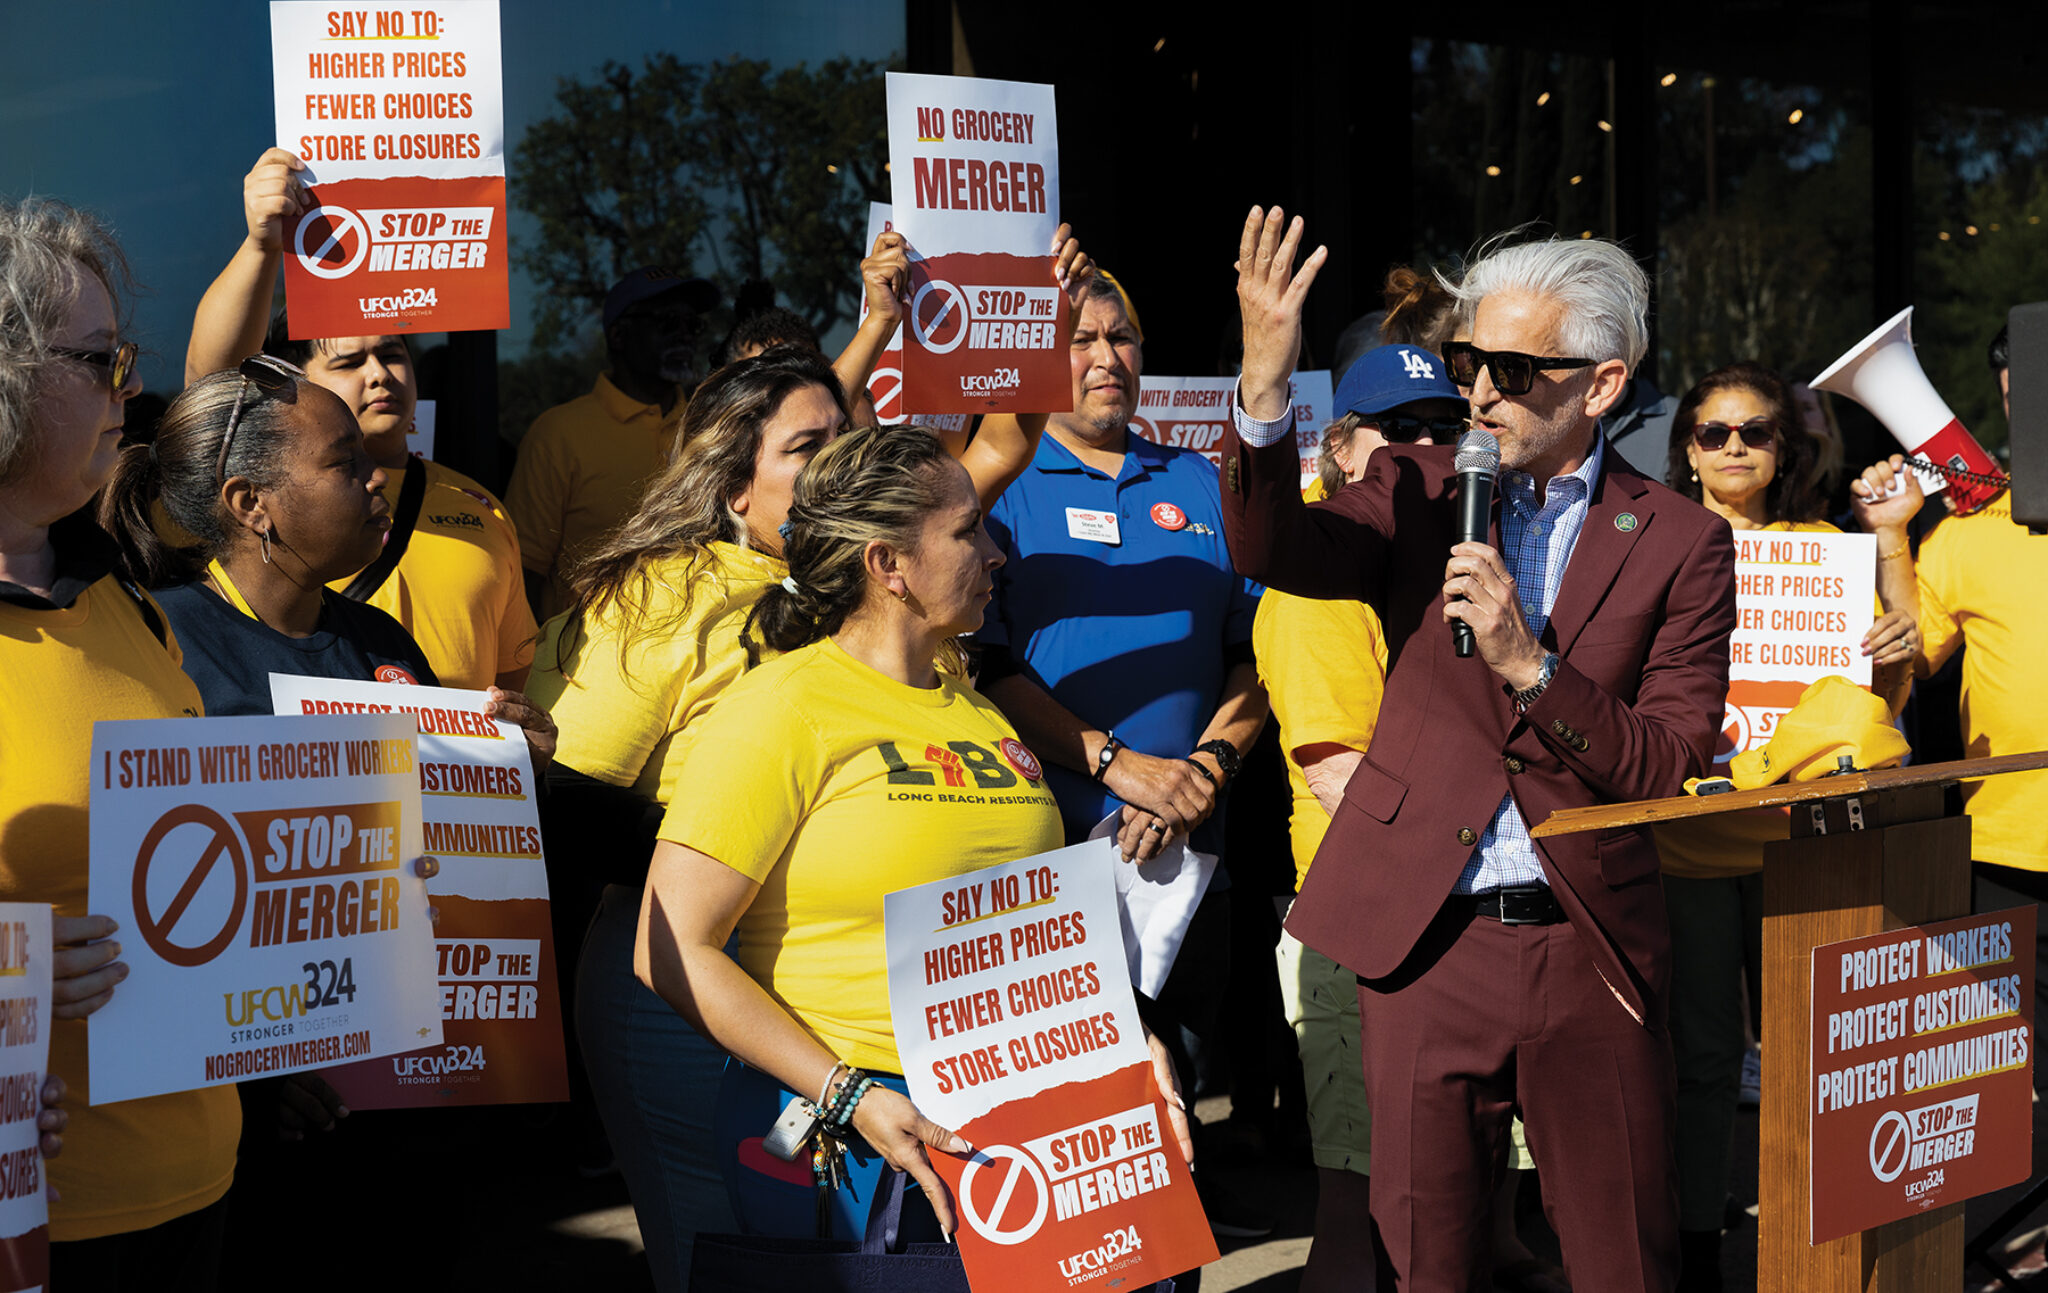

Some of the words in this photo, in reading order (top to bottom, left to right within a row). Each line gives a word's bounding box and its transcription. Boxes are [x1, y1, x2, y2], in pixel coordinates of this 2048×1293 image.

[328, 11, 367, 37] SAY
[376, 11, 404, 37] NO
[411, 11, 444, 37] TO:
[308, 52, 384, 78] HIGHER
[393, 52, 466, 78] PRICES
[305, 94, 375, 120] FEWER
[384, 93, 472, 119] CHOICES
[917, 106, 945, 138] NO
[952, 108, 1034, 144] GROCERY
[300, 135, 366, 161] STORE
[373, 133, 480, 160] CLOSURES
[913, 157, 1046, 213] MERGER
[379, 213, 446, 238] STOP
[452, 219, 483, 236] THE
[368, 242, 487, 272] MERGER
[363, 311, 398, 319] STRONGER
[400, 309, 432, 317] TOGETHER
[976, 290, 1026, 315] STOP
[1029, 299, 1052, 315] THE
[968, 322, 1056, 349] MERGER
[1398, 349, 1435, 380] LA
[1140, 390, 1170, 407] WITH
[1172, 390, 1225, 407] GROCERY
[1166, 423, 1224, 450] STOP
[1770, 541, 1792, 562] NO
[1800, 541, 1827, 563] TO:
[1782, 576, 1844, 598] PRICES
[1771, 609, 1846, 633] CHOICES
[1760, 643, 1851, 668] CLOSURES
[104, 750, 111, 789] I
[118, 747, 191, 789] STAND
[198, 745, 251, 784] WITH
[258, 741, 340, 781] GROCERY
[345, 738, 413, 777] WORKERS
[888, 793, 933, 802] LONG
[938, 794, 985, 804] BEACH
[990, 795, 1050, 806] RESIDENTS
[264, 814, 353, 874] STOP
[358, 827, 394, 864] THE
[423, 822, 540, 854] MMUNITIES
[941, 883, 983, 925] SAY
[990, 875, 1020, 914] NO
[1025, 866, 1060, 903] TO:
[249, 876, 401, 949] MERGER
[436, 944, 491, 976] TOP
[496, 954, 531, 976] THE
[924, 932, 1005, 985] HIGHER
[1010, 911, 1086, 962] PRICES
[1840, 939, 1921, 993] PROTECT
[1926, 921, 2012, 975] WORKERS
[438, 985, 538, 1020] ERGER
[925, 988, 1004, 1041] FEWER
[1007, 961, 1100, 1017] CHOICES
[1828, 997, 1908, 1054] PROTECT
[1913, 973, 2021, 1034] CUSTOMERS
[231, 1023, 294, 1044] STRONGER
[299, 1014, 350, 1033] TOGETHER
[205, 1030, 371, 1081] NOGROCERYMERGER.COM
[932, 1044, 1008, 1095] STORE
[1007, 1011, 1120, 1072] CLOSURES
[398, 1077, 440, 1085] STRONGER
[1818, 1056, 1898, 1115] PROTECT
[1903, 1025, 2028, 1092] COMMUNITIES
[1917, 1104, 1954, 1137] STOP
[1956, 1106, 1974, 1126] THE
[1050, 1123, 1117, 1173] STOP
[1121, 1121, 1155, 1150] THE
[1909, 1129, 1975, 1171] MERGER
[0, 1146, 39, 1200] SURES
[1052, 1152, 1171, 1222] MERGER
[1068, 1267, 1108, 1287] STRONGER
[1109, 1255, 1143, 1273] TOGETHER
